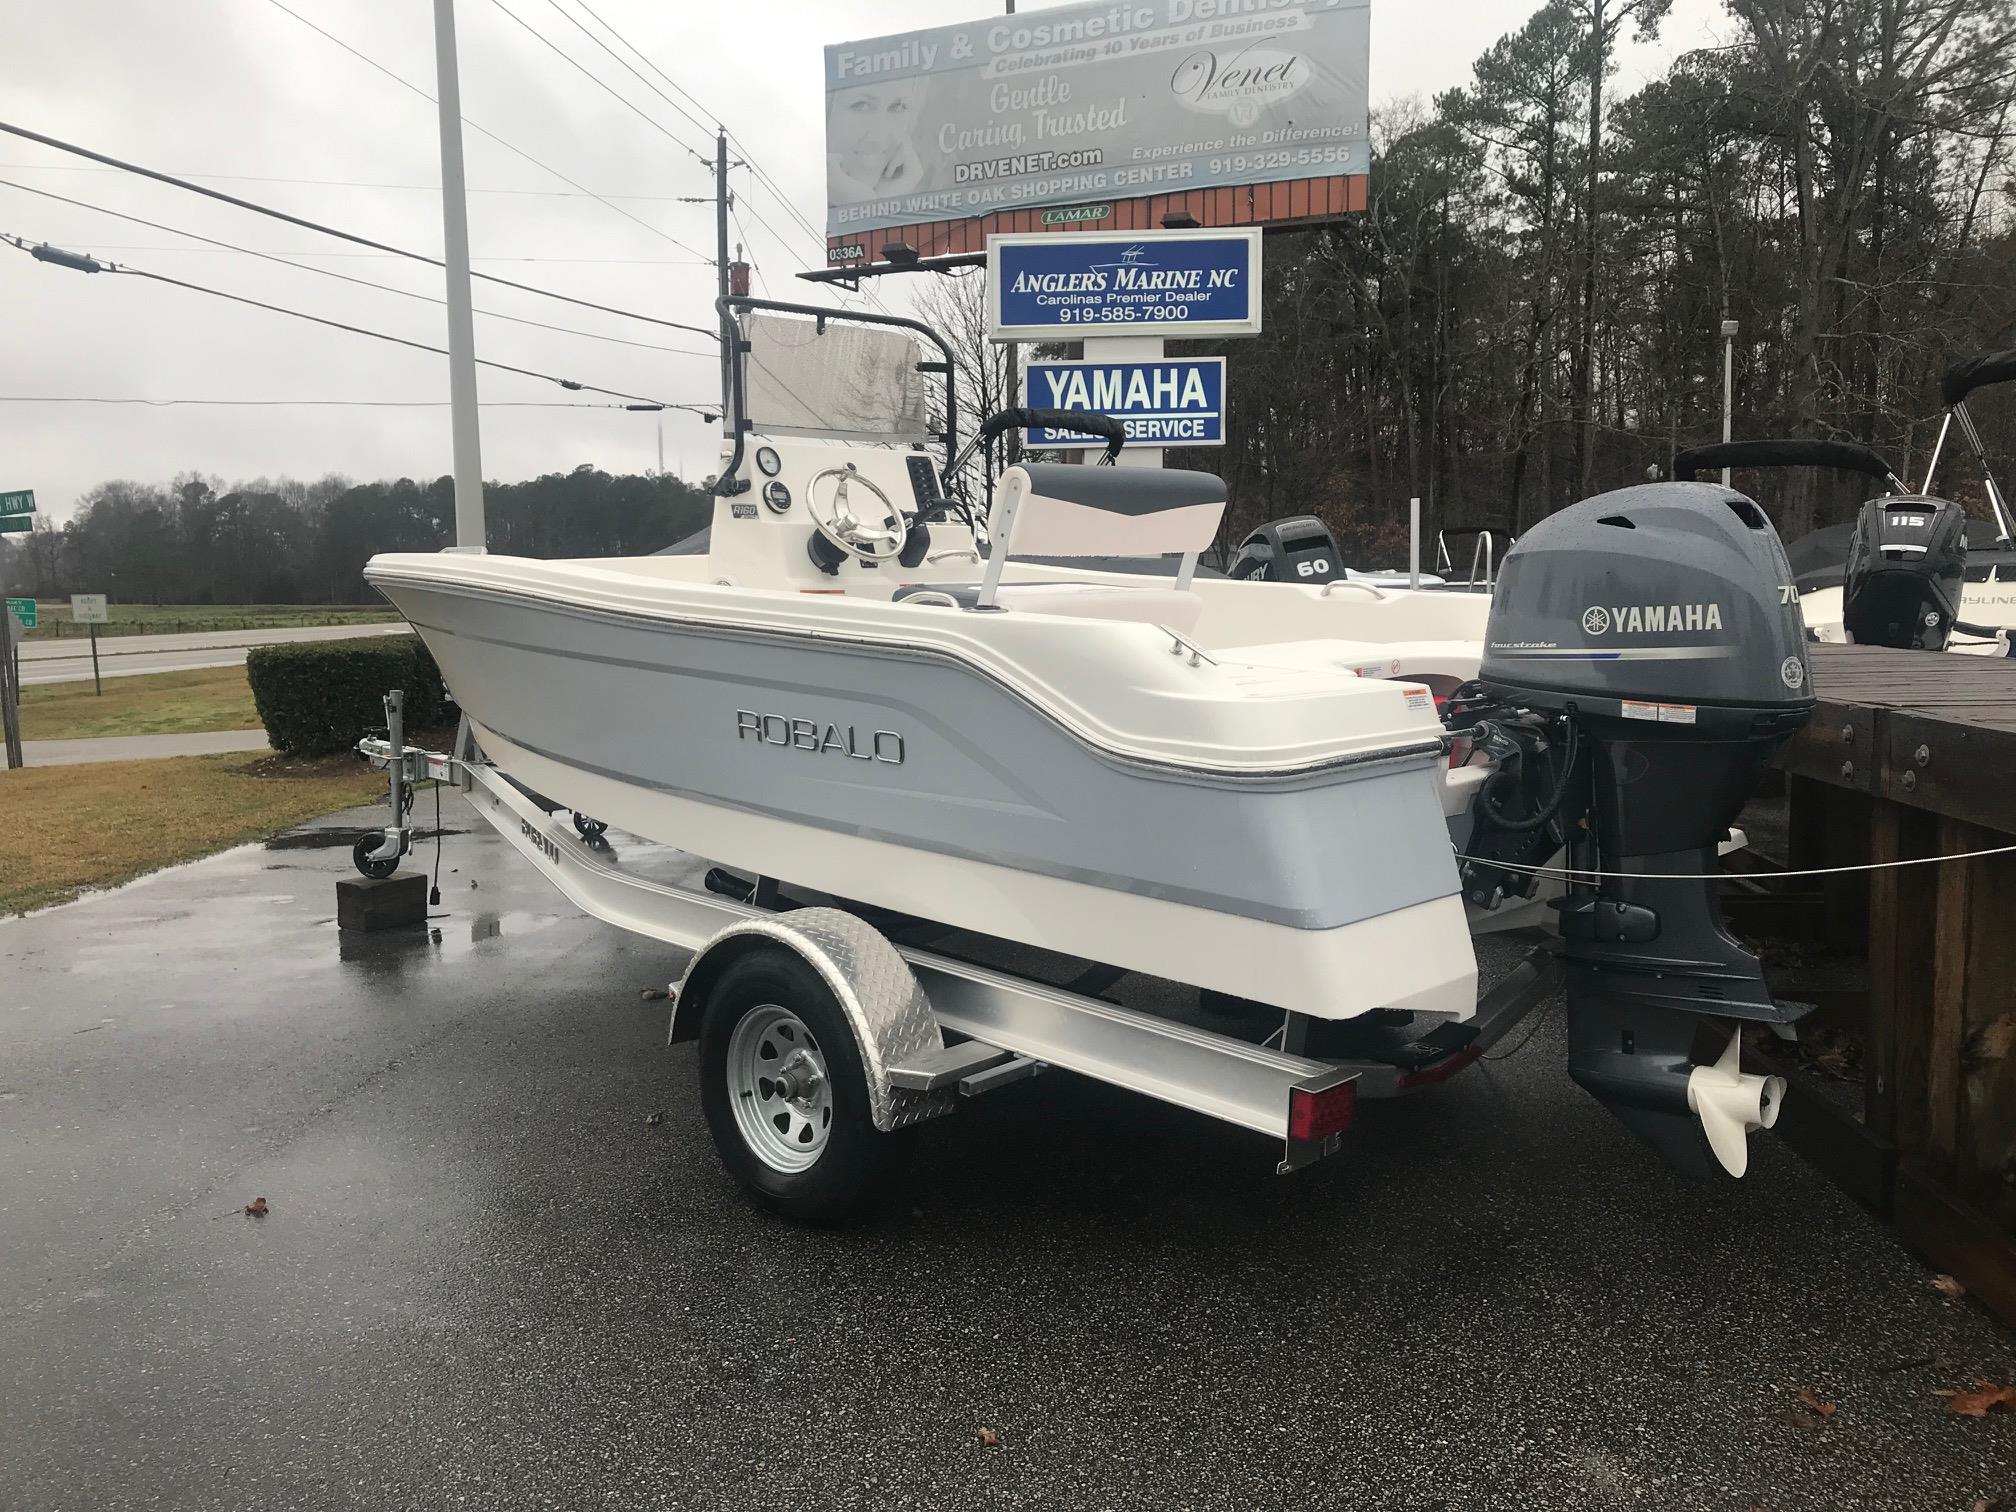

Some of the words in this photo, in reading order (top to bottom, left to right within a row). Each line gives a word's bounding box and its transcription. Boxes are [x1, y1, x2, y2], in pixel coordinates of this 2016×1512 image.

[838, 40, 938, 80] Family
[951, 32, 975, 60] &
[987, 4, 1153, 53] Cosmetic
[995, 45, 1096, 73] Celebrating
[1104, 41, 1123, 55] 10
[1130, 34, 1179, 51] Years
[1185, 25, 1206, 42] of
[1210, 15, 1298, 38] Business
[991, 74, 1072, 113] Gentle
[1207, 89, 1240, 100] FAMILY
[1245, 81, 1295, 96] DENTISTRY
[1032, 97, 1127, 139] Trusted
[1132, 138, 1224, 161] Experience
[1230, 133, 1257, 149] the
[1262, 123, 1360, 143] Difference!
[955, 149, 1102, 183] DRVENET.com
[838, 200, 901, 223] BEHIND
[902, 191, 962, 212] WHITE
[968, 185, 1008, 204] OAK
[1011, 174, 1107, 199] SHOPPING
[1114, 162, 1193, 186] CENTER
[1209, 146, 1350, 175] 919-329-5556
[1046, 207, 1103, 222] LAMAR
[829, 246, 863, 261] 0336A
[1207, 268, 1238, 288] NC
[1036, 293, 1102, 305] Carolinas
[1106, 292, 1161, 304] Premier
[1166, 290, 1212, 302] Dealer
[1059, 305, 1189, 322] 919-585-7900
[1045, 367, 1208, 411] YAMAHA
[1123, 419, 1205, 438] SERVICE
[1892, 516, 1925, 527] 115
[1296, 558, 1330, 577] 60
[1777, 585, 1800, 604] 70
[1611, 603, 1723, 633] YAMAHA
[736, 709, 905, 765] ROBALO
